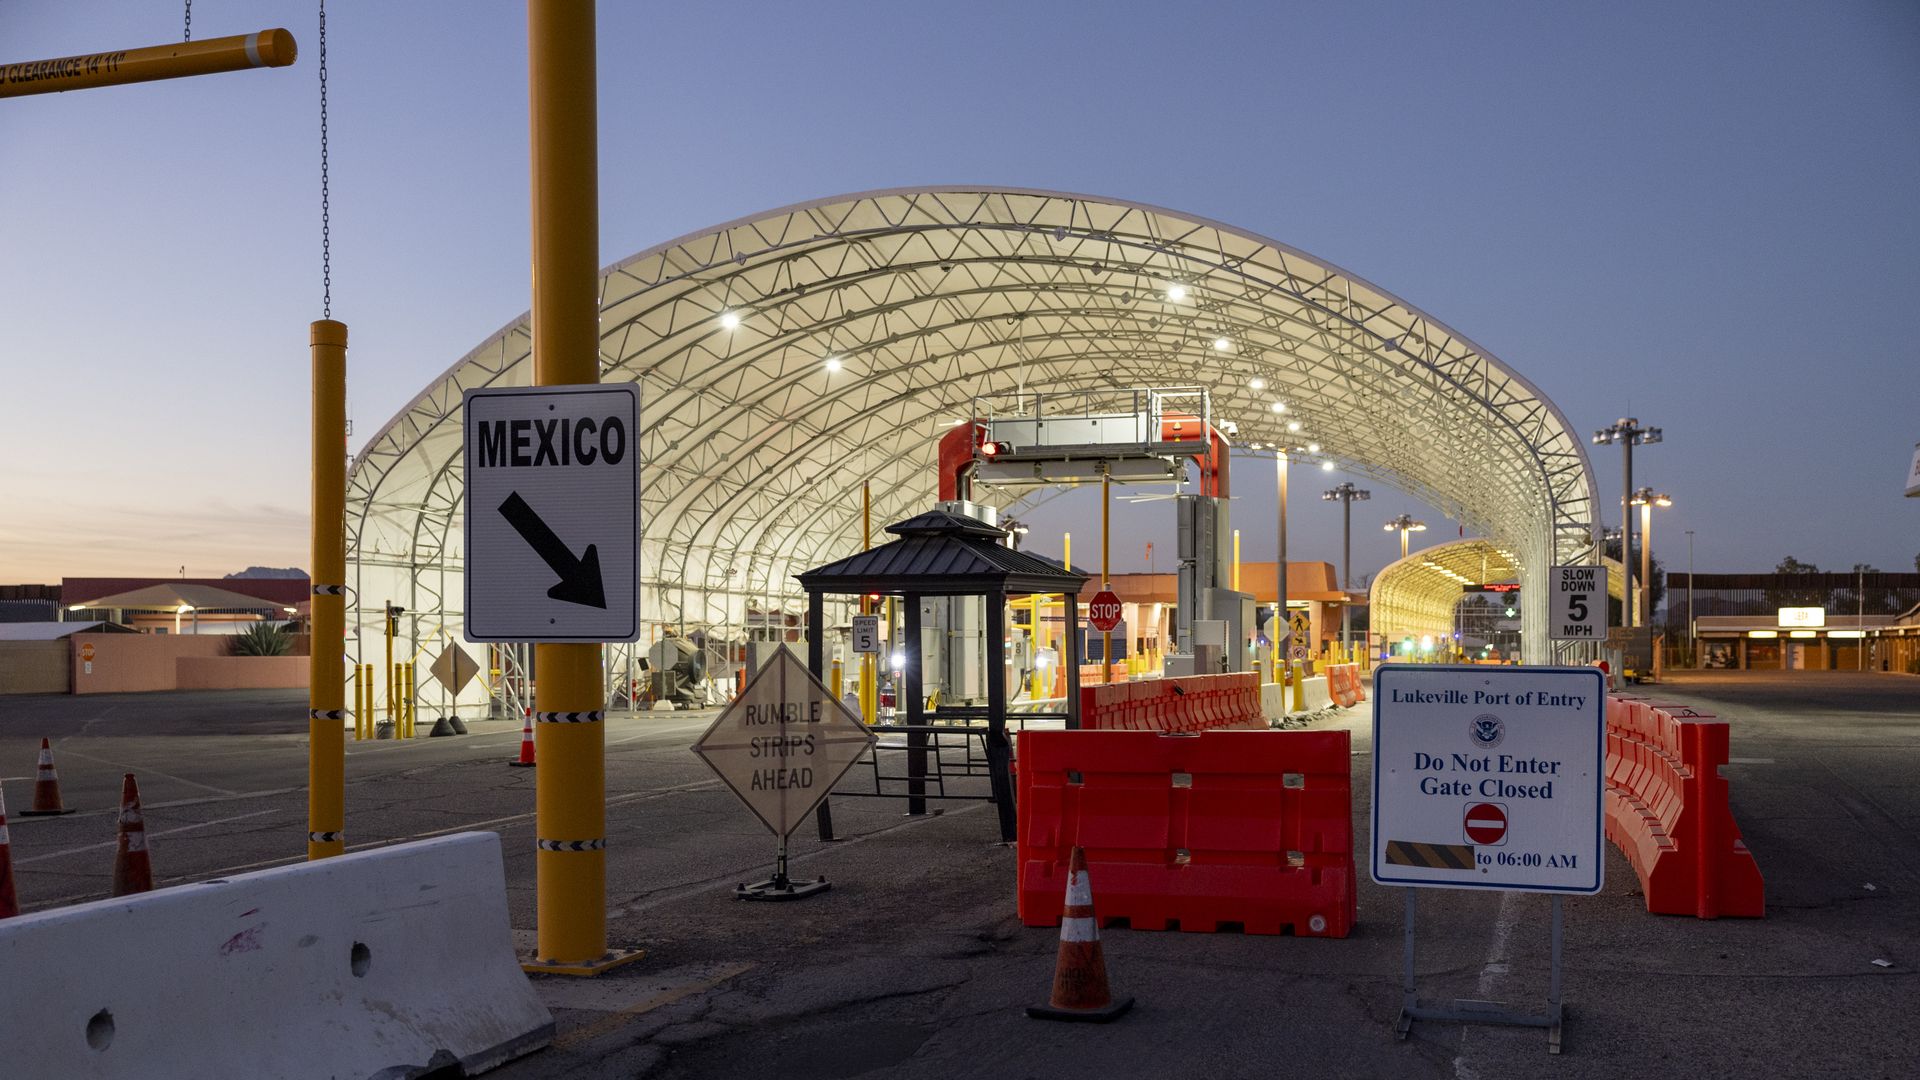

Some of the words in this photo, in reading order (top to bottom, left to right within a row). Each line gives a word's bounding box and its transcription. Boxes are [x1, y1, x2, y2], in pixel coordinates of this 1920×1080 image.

[8, 58, 81, 83] CLEARANCE
[478, 416, 626, 468] MEXICO
[1562, 569, 1595, 580] SLOW
[1561, 581, 1595, 592] DOWN
[1091, 603, 1120, 619] STOP
[1568, 594, 1588, 622] 5
[861, 635, 871, 648] 5
[1563, 625, 1593, 636] MPH
[82, 648, 95, 657] STOP
[1392, 689, 1468, 705] Lukeville
[1473, 690, 1511, 706] Port
[1515, 691, 1533, 706] of
[1537, 691, 1586, 711] Entry
[745, 701, 821, 726] RUMBLE
[750, 734, 815, 758] STRIPS
[1414, 752, 1444, 771] Do
[1451, 753, 1490, 772] Not
[1498, 755, 1561, 775] Enter
[751, 768, 813, 791] AHEAD
[1420, 777, 1472, 796] Gate
[1479, 778, 1553, 799] Closed
[1477, 852, 1491, 865] to
[1497, 852, 1541, 867] 06:00
[1545, 854, 1578, 869] AM
